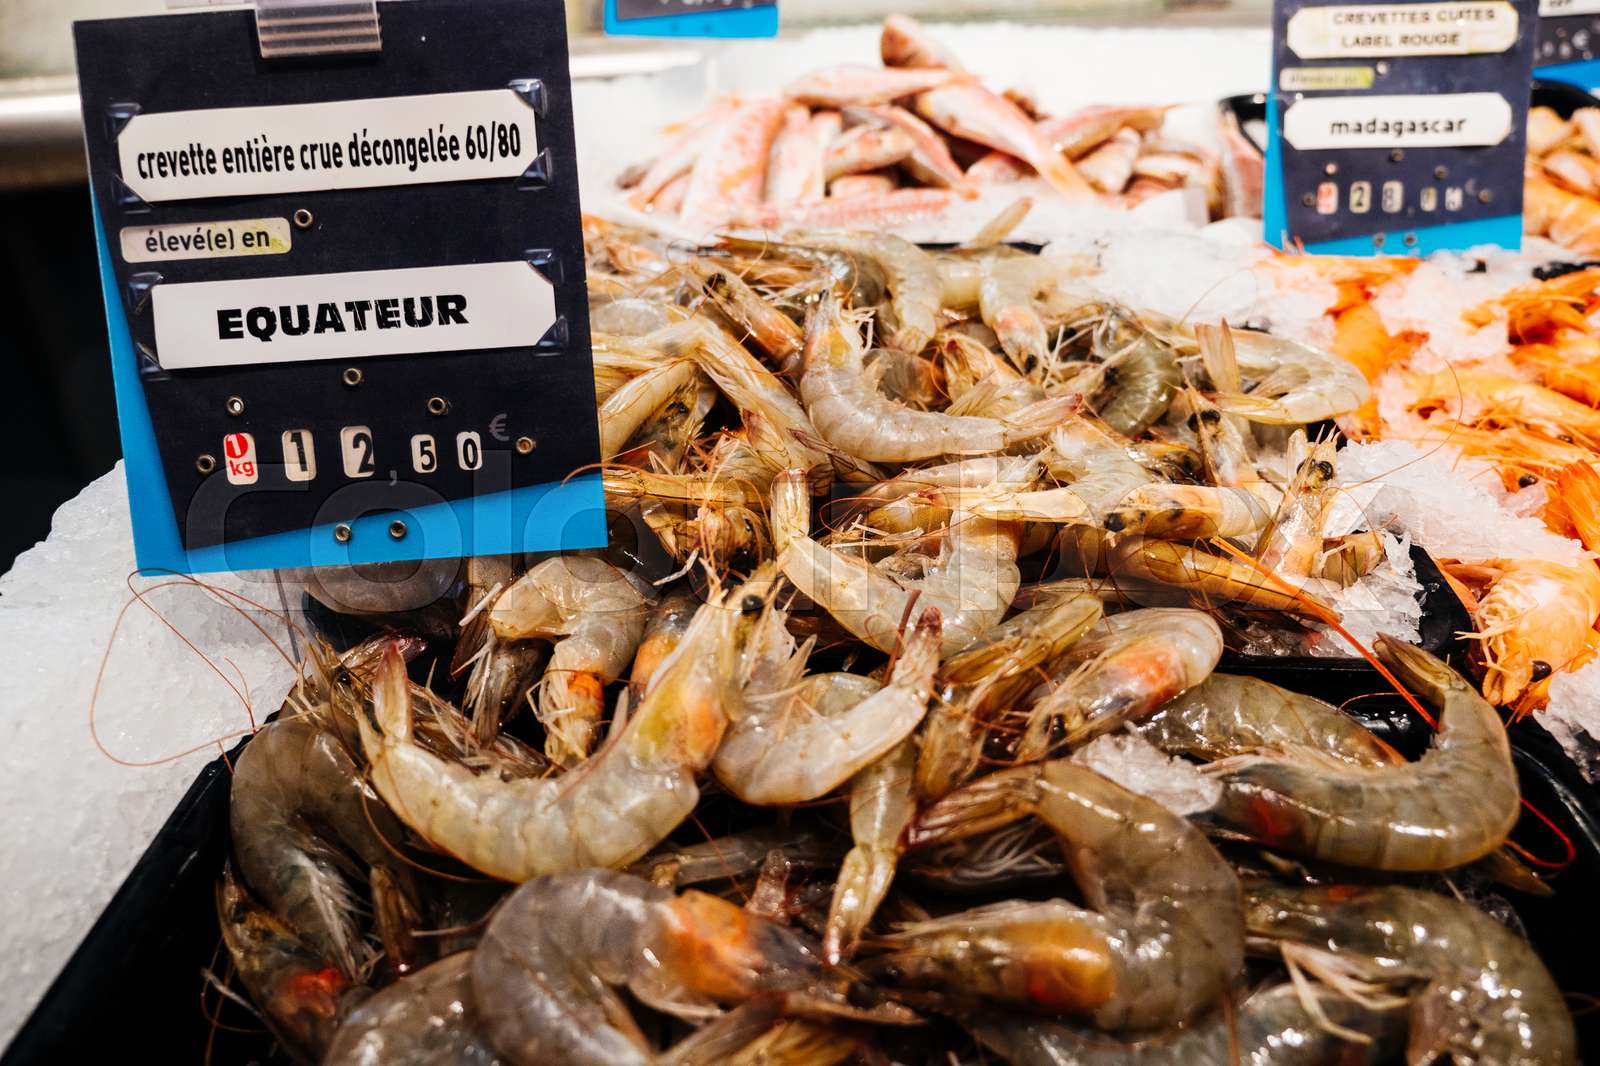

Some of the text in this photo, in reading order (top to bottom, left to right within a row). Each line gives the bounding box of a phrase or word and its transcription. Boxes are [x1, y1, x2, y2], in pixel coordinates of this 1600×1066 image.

[1333, 8, 1495, 25] CREVETTES CUITES
[1341, 33, 1460, 48] LABEL ROUGE
[1330, 117, 1468, 137] madagascar
[137, 120, 522, 180] crevette entière crue décongelée 60/80
[145, 226, 270, 253] élevé(e) en
[216, 294, 469, 342] EQUATEUR
[229, 460, 255, 477] kg
